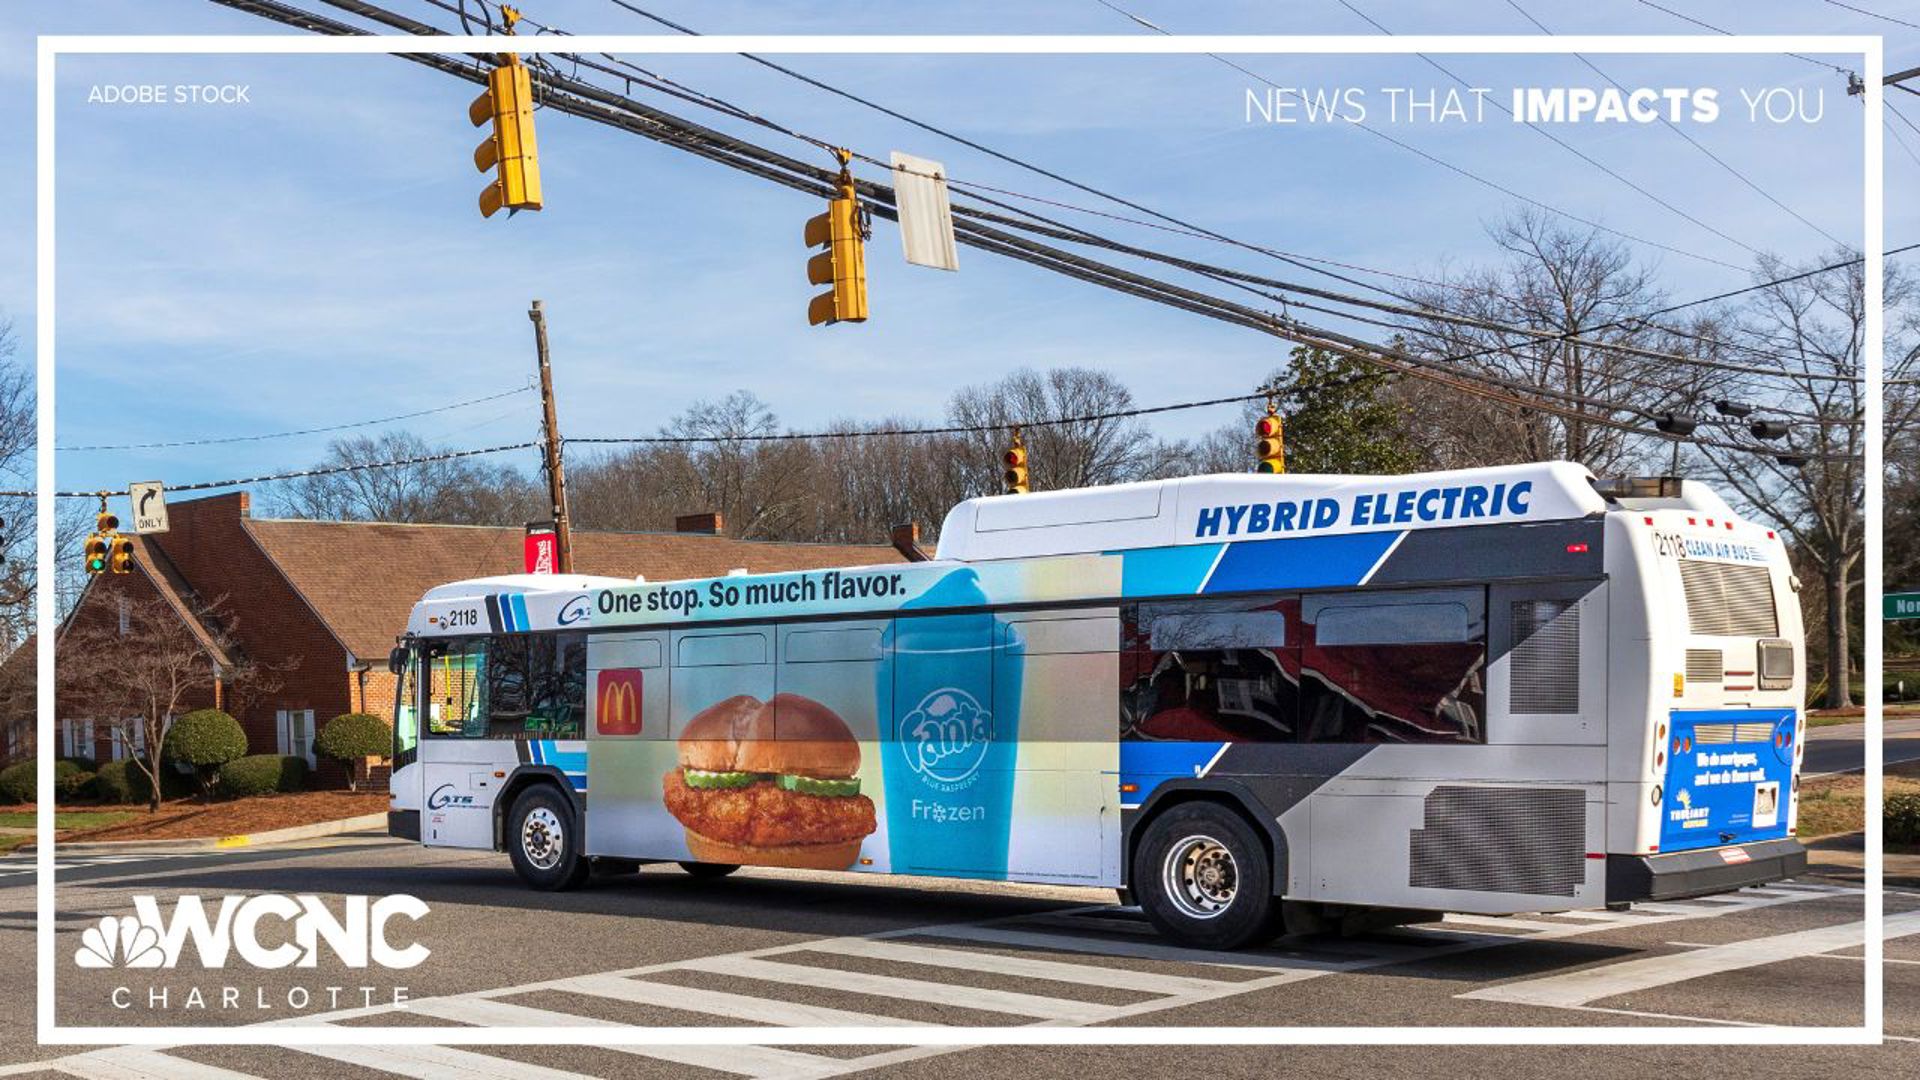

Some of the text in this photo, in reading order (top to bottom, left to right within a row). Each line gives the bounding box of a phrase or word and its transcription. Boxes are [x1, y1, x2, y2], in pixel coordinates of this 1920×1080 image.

[1195, 480, 1532, 538] HYBRID ELECTRIC
[139, 517, 163, 529] ONLY
[1655, 532, 1686, 558] 2118
[1686, 539, 1750, 560] CLEAN AIR BUS
[598, 571, 906, 616] One stop. So much flavor.
[449, 609, 477, 626] 2118
[900, 702, 992, 773] Fanta
[912, 799, 985, 822] Frozen
